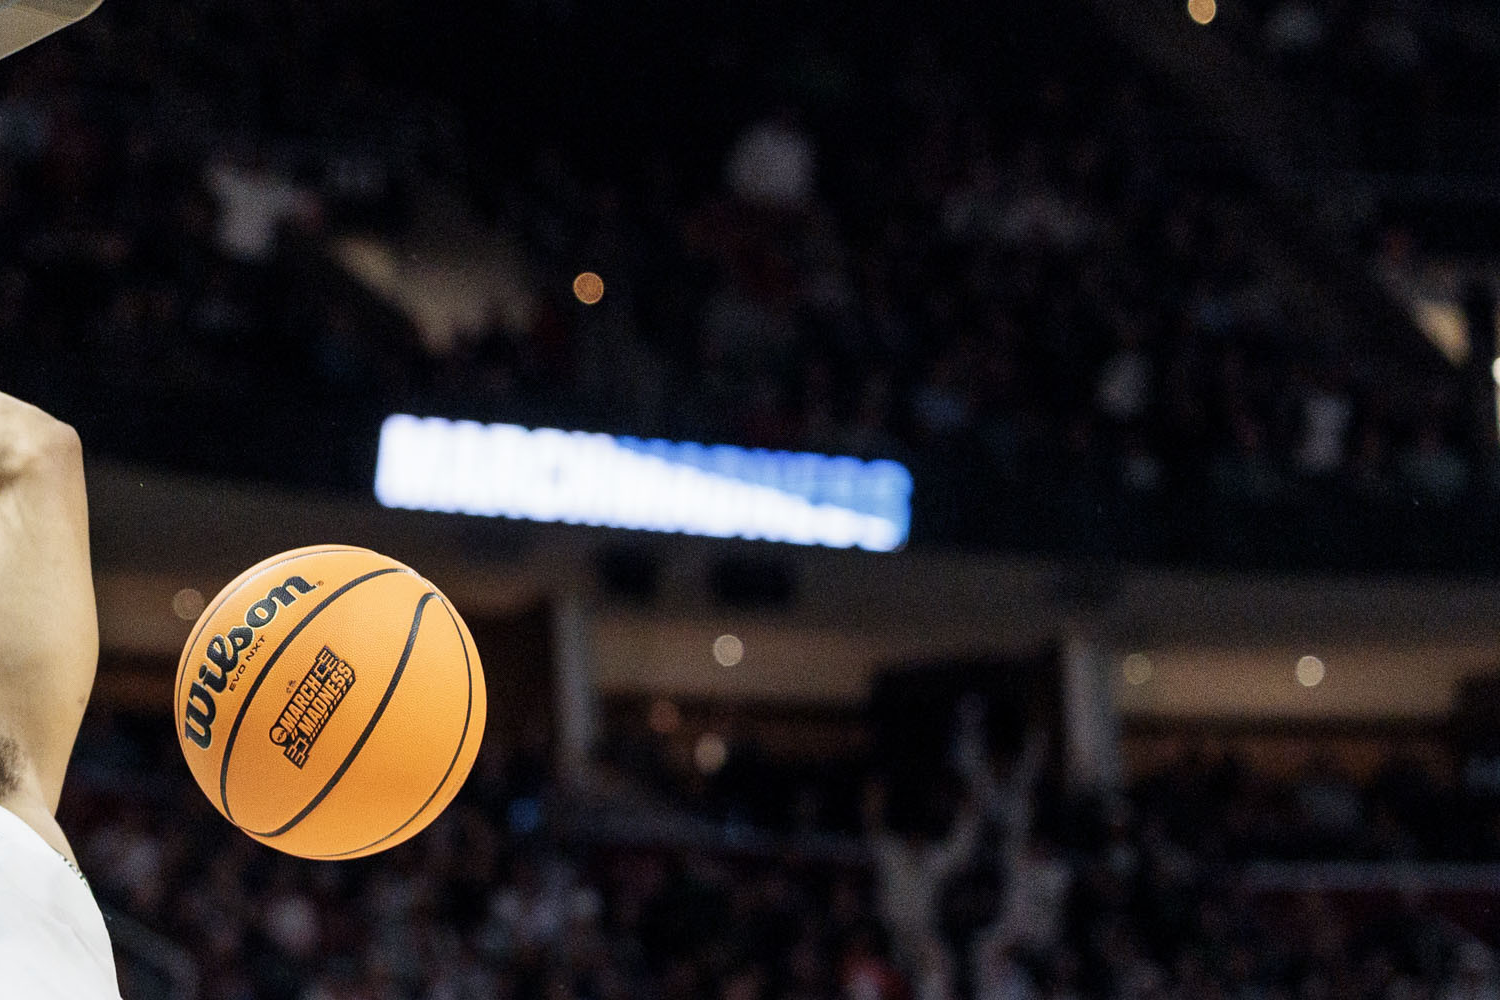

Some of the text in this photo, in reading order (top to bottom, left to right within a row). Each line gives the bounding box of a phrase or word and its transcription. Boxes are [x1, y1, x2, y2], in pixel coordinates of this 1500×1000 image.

[185, 575, 318, 750] Wilson
[229, 635, 266, 692] EVO NXT
[279, 673, 322, 734] MARCH
[297, 661, 353, 738] MADNESS
